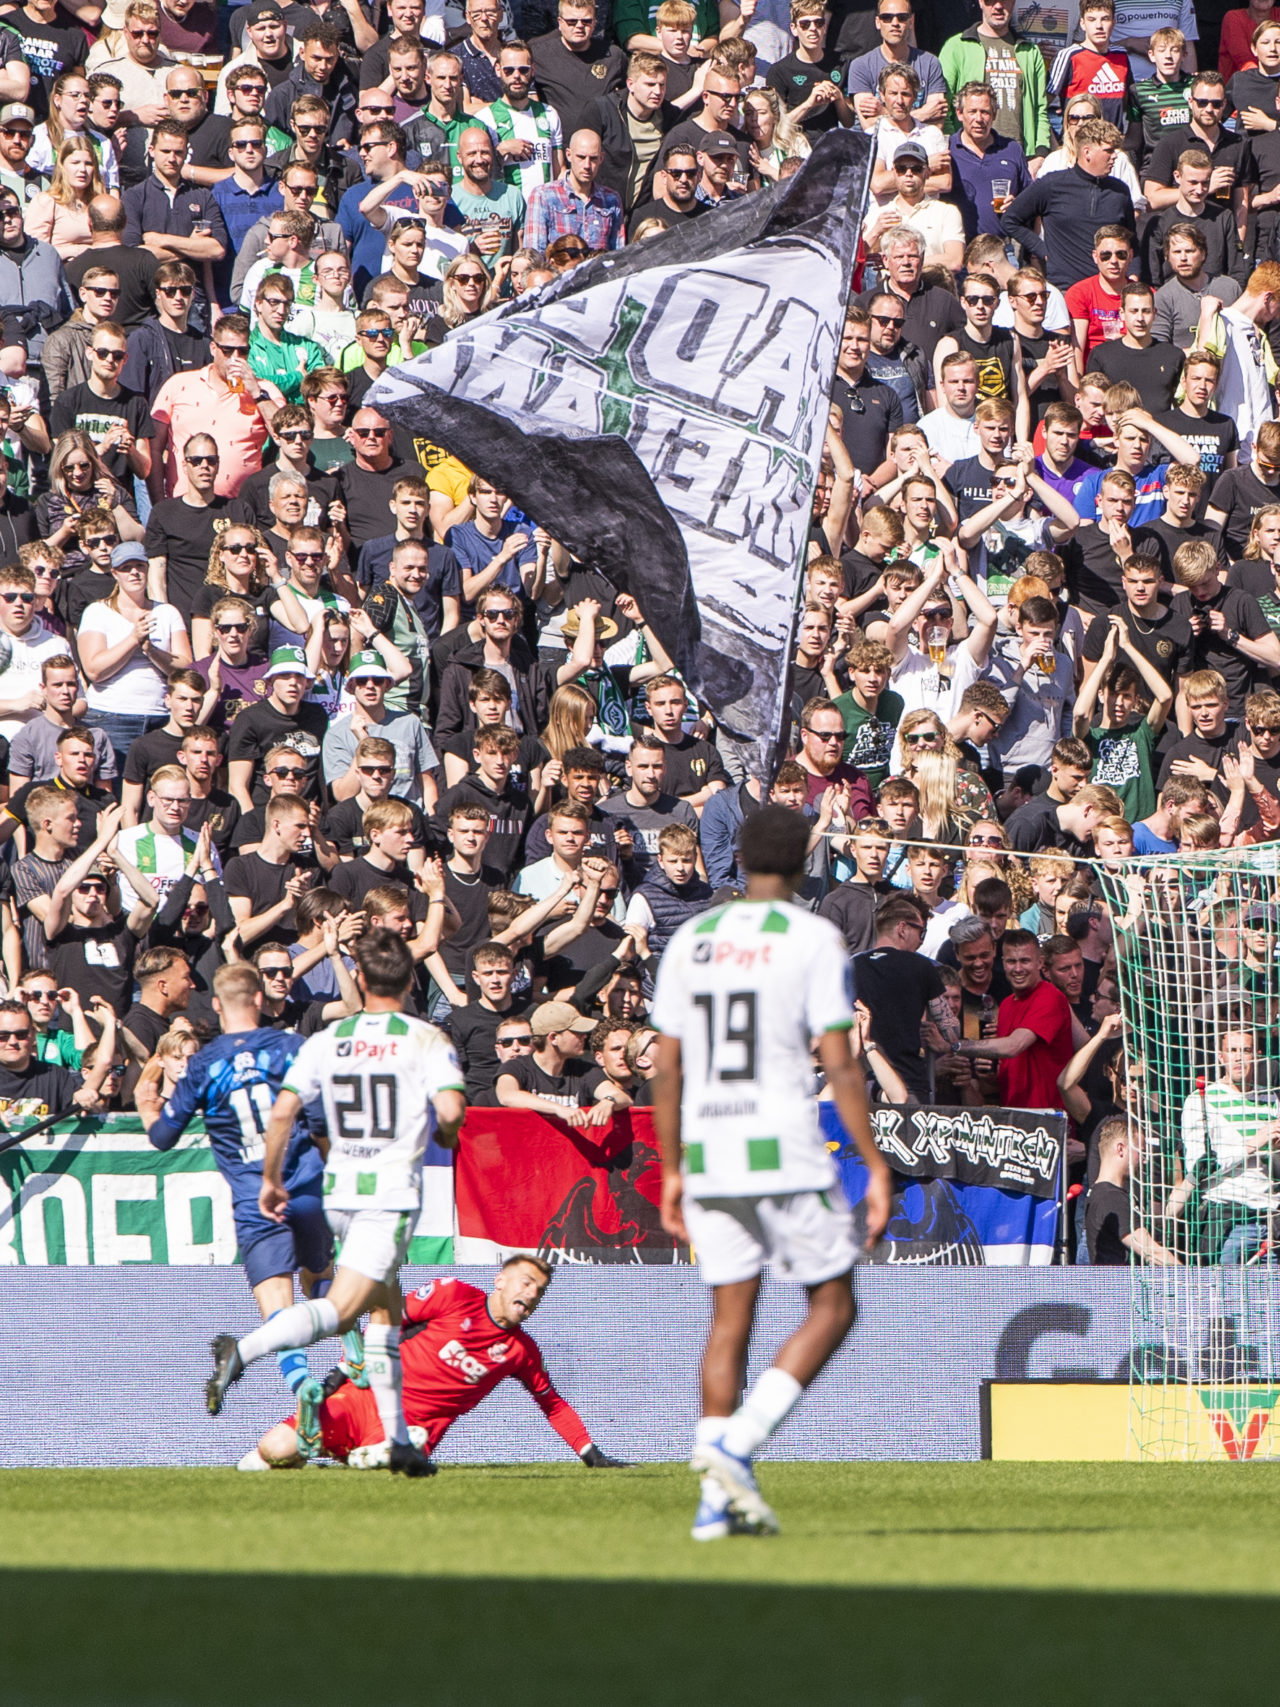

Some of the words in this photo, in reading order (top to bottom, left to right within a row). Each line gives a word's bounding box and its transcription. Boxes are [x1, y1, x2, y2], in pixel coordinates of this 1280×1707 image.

[990, 77, 1017, 89] 2019
[1088, 83, 1125, 94] adidas
[1160, 107, 1190, 118] OFFICE
[1160, 116, 1190, 126] CENTRE
[1193, 444, 1218, 455] AAR
[1199, 453, 1225, 465] ROTE
[321, 700, 357, 714] essen
[694, 990, 757, 1083] 19
[354, 1041, 398, 1061] Payt
[332, 1074, 397, 1139] 20
[229, 1083, 272, 1145] 11
